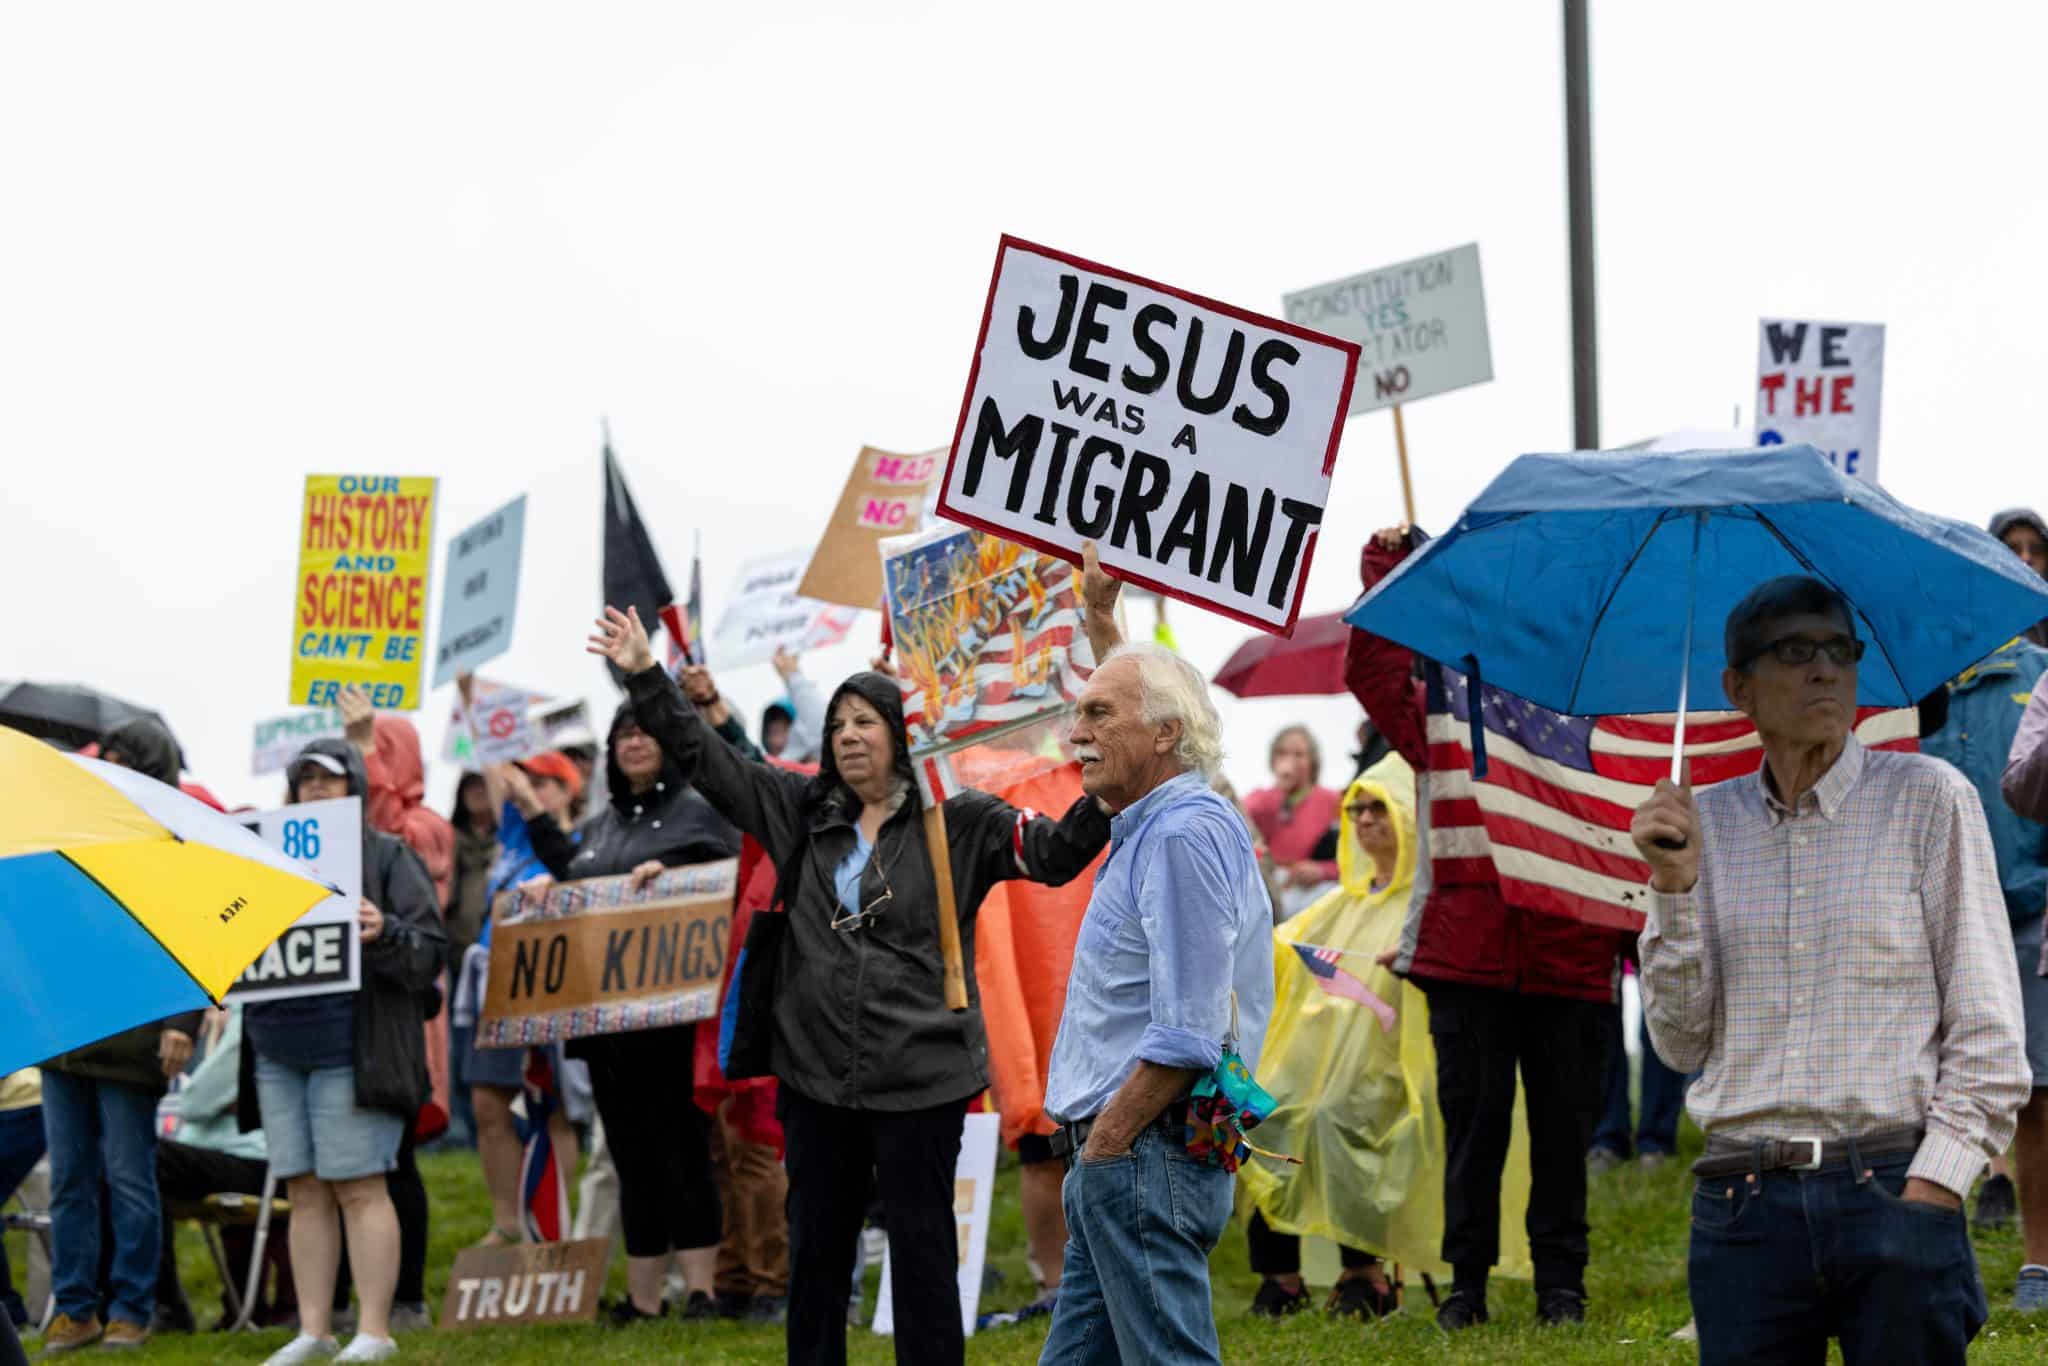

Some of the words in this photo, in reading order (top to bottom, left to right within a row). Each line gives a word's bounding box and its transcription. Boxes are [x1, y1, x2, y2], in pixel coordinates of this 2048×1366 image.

[1363, 299, 1409, 331] YES
[1017, 273, 1300, 436] JESUS
[1766, 323, 1851, 368] WE
[1374, 364, 1411, 399] NO
[1760, 373, 1855, 417] THE
[1052, 379, 1145, 435] WAS
[1171, 423, 1197, 454] A
[338, 476, 400, 493] OUR
[961, 395, 1326, 610] MIGRANT
[307, 495, 428, 551] HISTORY
[863, 499, 907, 526] NO
[334, 555, 396, 572] AND
[302, 572, 422, 630] SCIENCE
[299, 632, 373, 660] CAN'T
[383, 636, 419, 661] BE
[307, 680, 404, 708] ERED
[283, 818, 320, 859] 86
[234, 926, 342, 983] ACE
[510, 933, 568, 1000] NO
[601, 915, 728, 992] KINGS
[456, 1269, 585, 1321] TRUTH
